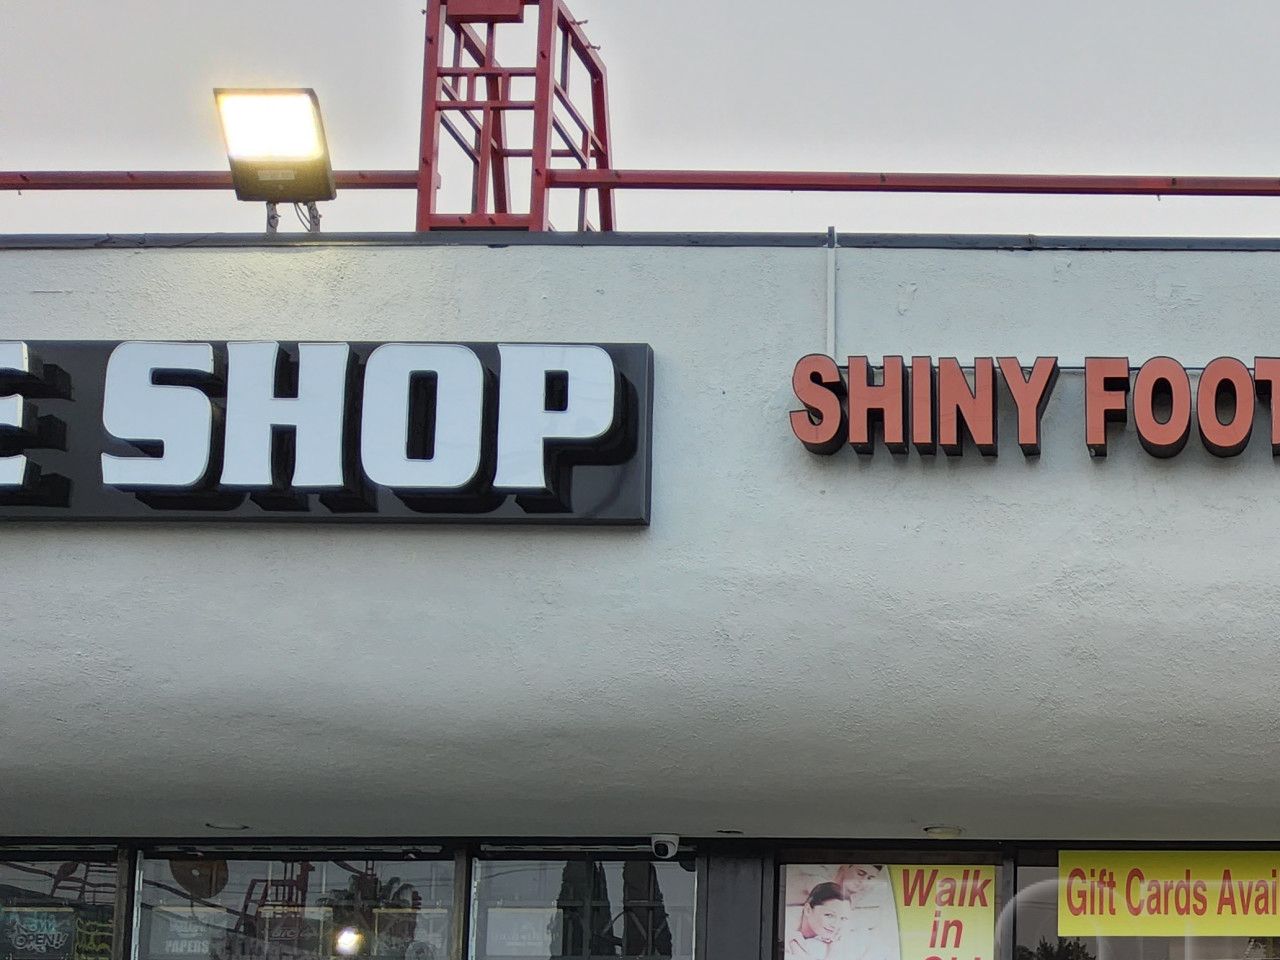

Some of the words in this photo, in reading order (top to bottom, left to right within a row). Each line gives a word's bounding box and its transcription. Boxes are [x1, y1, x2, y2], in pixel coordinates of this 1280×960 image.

[101, 341, 616, 489] SHOP
[790, 353, 1059, 452] SHINY
[902, 868, 992, 908] Walk
[1066, 867, 1117, 917] Gift
[1125, 867, 1208, 917] Cards
[929, 910, 964, 949] in
